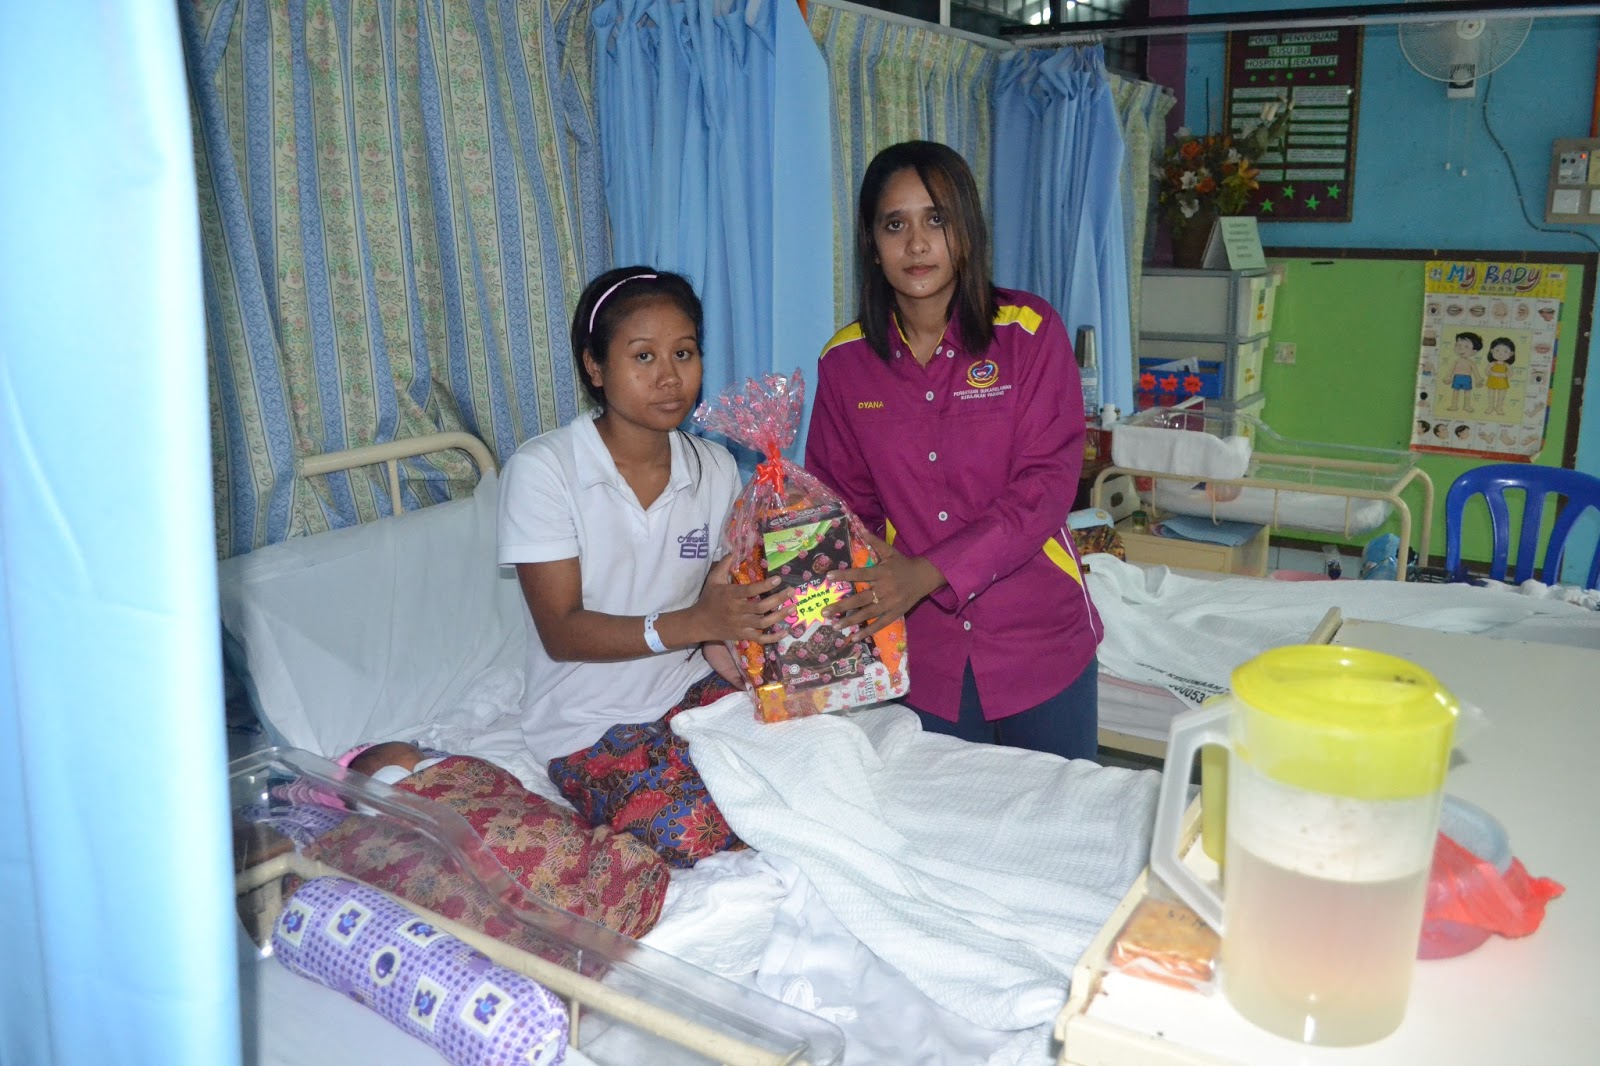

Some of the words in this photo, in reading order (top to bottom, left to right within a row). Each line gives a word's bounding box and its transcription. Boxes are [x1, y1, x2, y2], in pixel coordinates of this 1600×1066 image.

[1282, 31, 1337, 43] PENYUSUAN
[1270, 46, 1292, 55] SUSU
[1246, 59, 1287, 68] HOSPITAL
[1291, 56, 1336, 66] JERANTUT
[858, 401, 884, 409] DYANA
